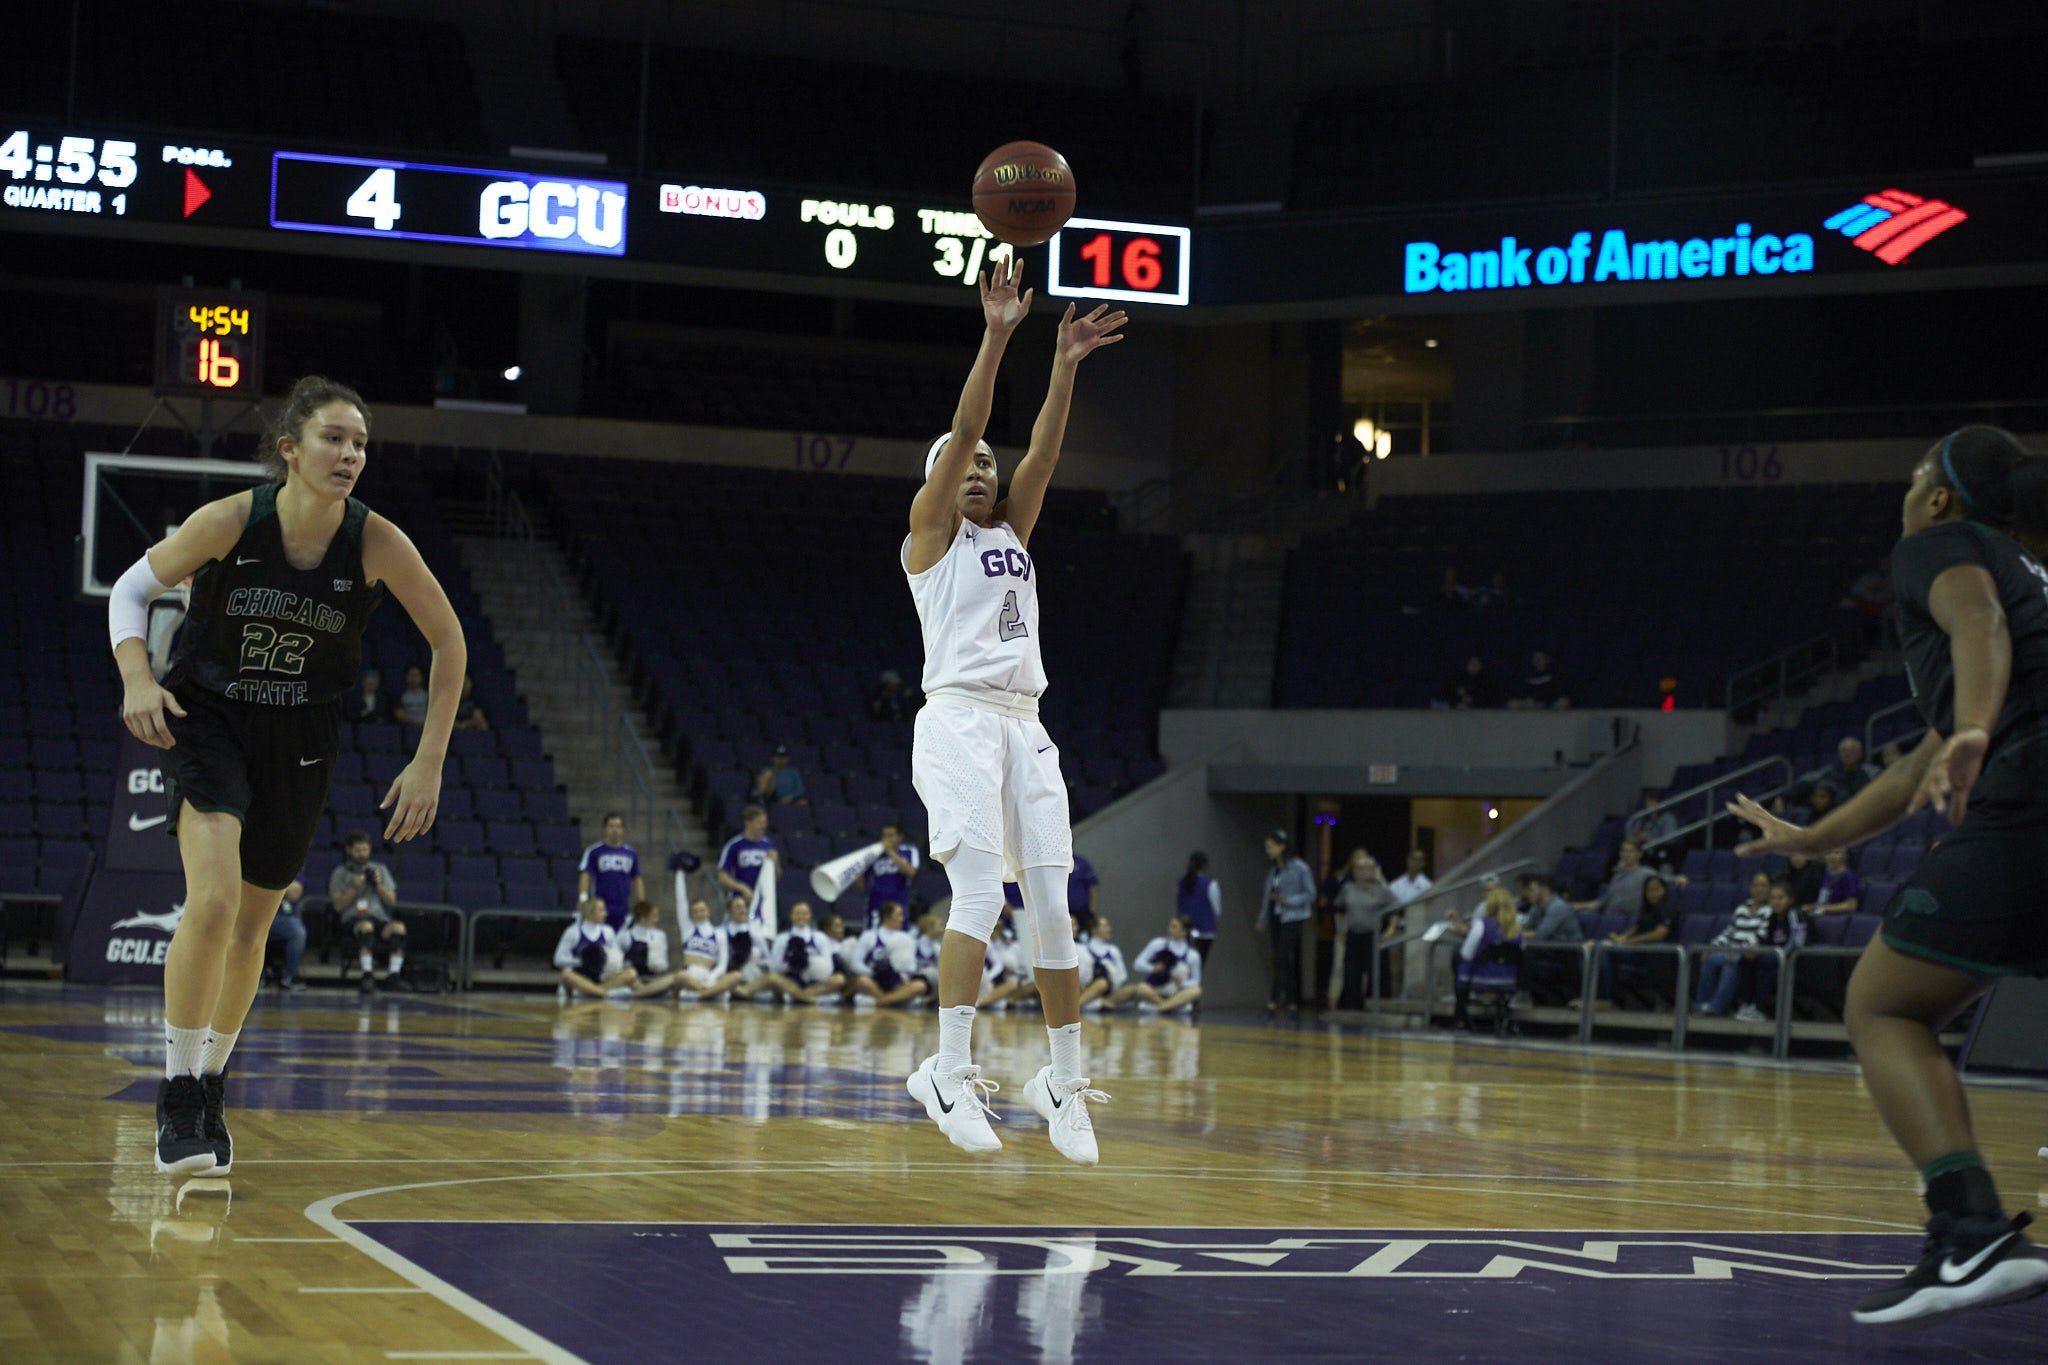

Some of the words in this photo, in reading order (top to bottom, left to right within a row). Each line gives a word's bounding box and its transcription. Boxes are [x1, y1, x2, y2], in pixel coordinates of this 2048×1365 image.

[0, 131, 137, 188] 4:55
[994, 163, 1064, 186] Wilson
[4, 185, 101, 213] QUARTER
[112, 193, 126, 215] 1
[347, 168, 401, 231] 4
[479, 181, 626, 248] GCU
[660, 184, 766, 220] BONUS
[801, 200, 894, 230] FOULS
[1008, 198, 1055, 215] NCAA
[825, 229, 857, 269] 0
[933, 237, 1013, 285] 3/1
[1081, 234, 1163, 290] 16
[1404, 236, 1533, 293] Bank
[1535, 231, 1593, 284] of
[1593, 223, 1814, 282] America
[190, 305, 249, 336] 4:54
[198, 338, 240, 388] 16
[7, 380, 76, 419] 108
[793, 432, 855, 470] 107
[1717, 446, 1783, 480] 106
[980, 548, 1031, 582] GCU
[226, 588, 346, 633] CHICAGO
[999, 590, 1029, 643] 2
[239, 623, 314, 675] 22
[225, 679, 308, 706] STATE
[128, 768, 165, 794] GC
[597, 853, 635, 874] GCU
[738, 850, 768, 868] GC
[873, 857, 899, 876] GC
[106, 938, 166, 965] GCU.E
